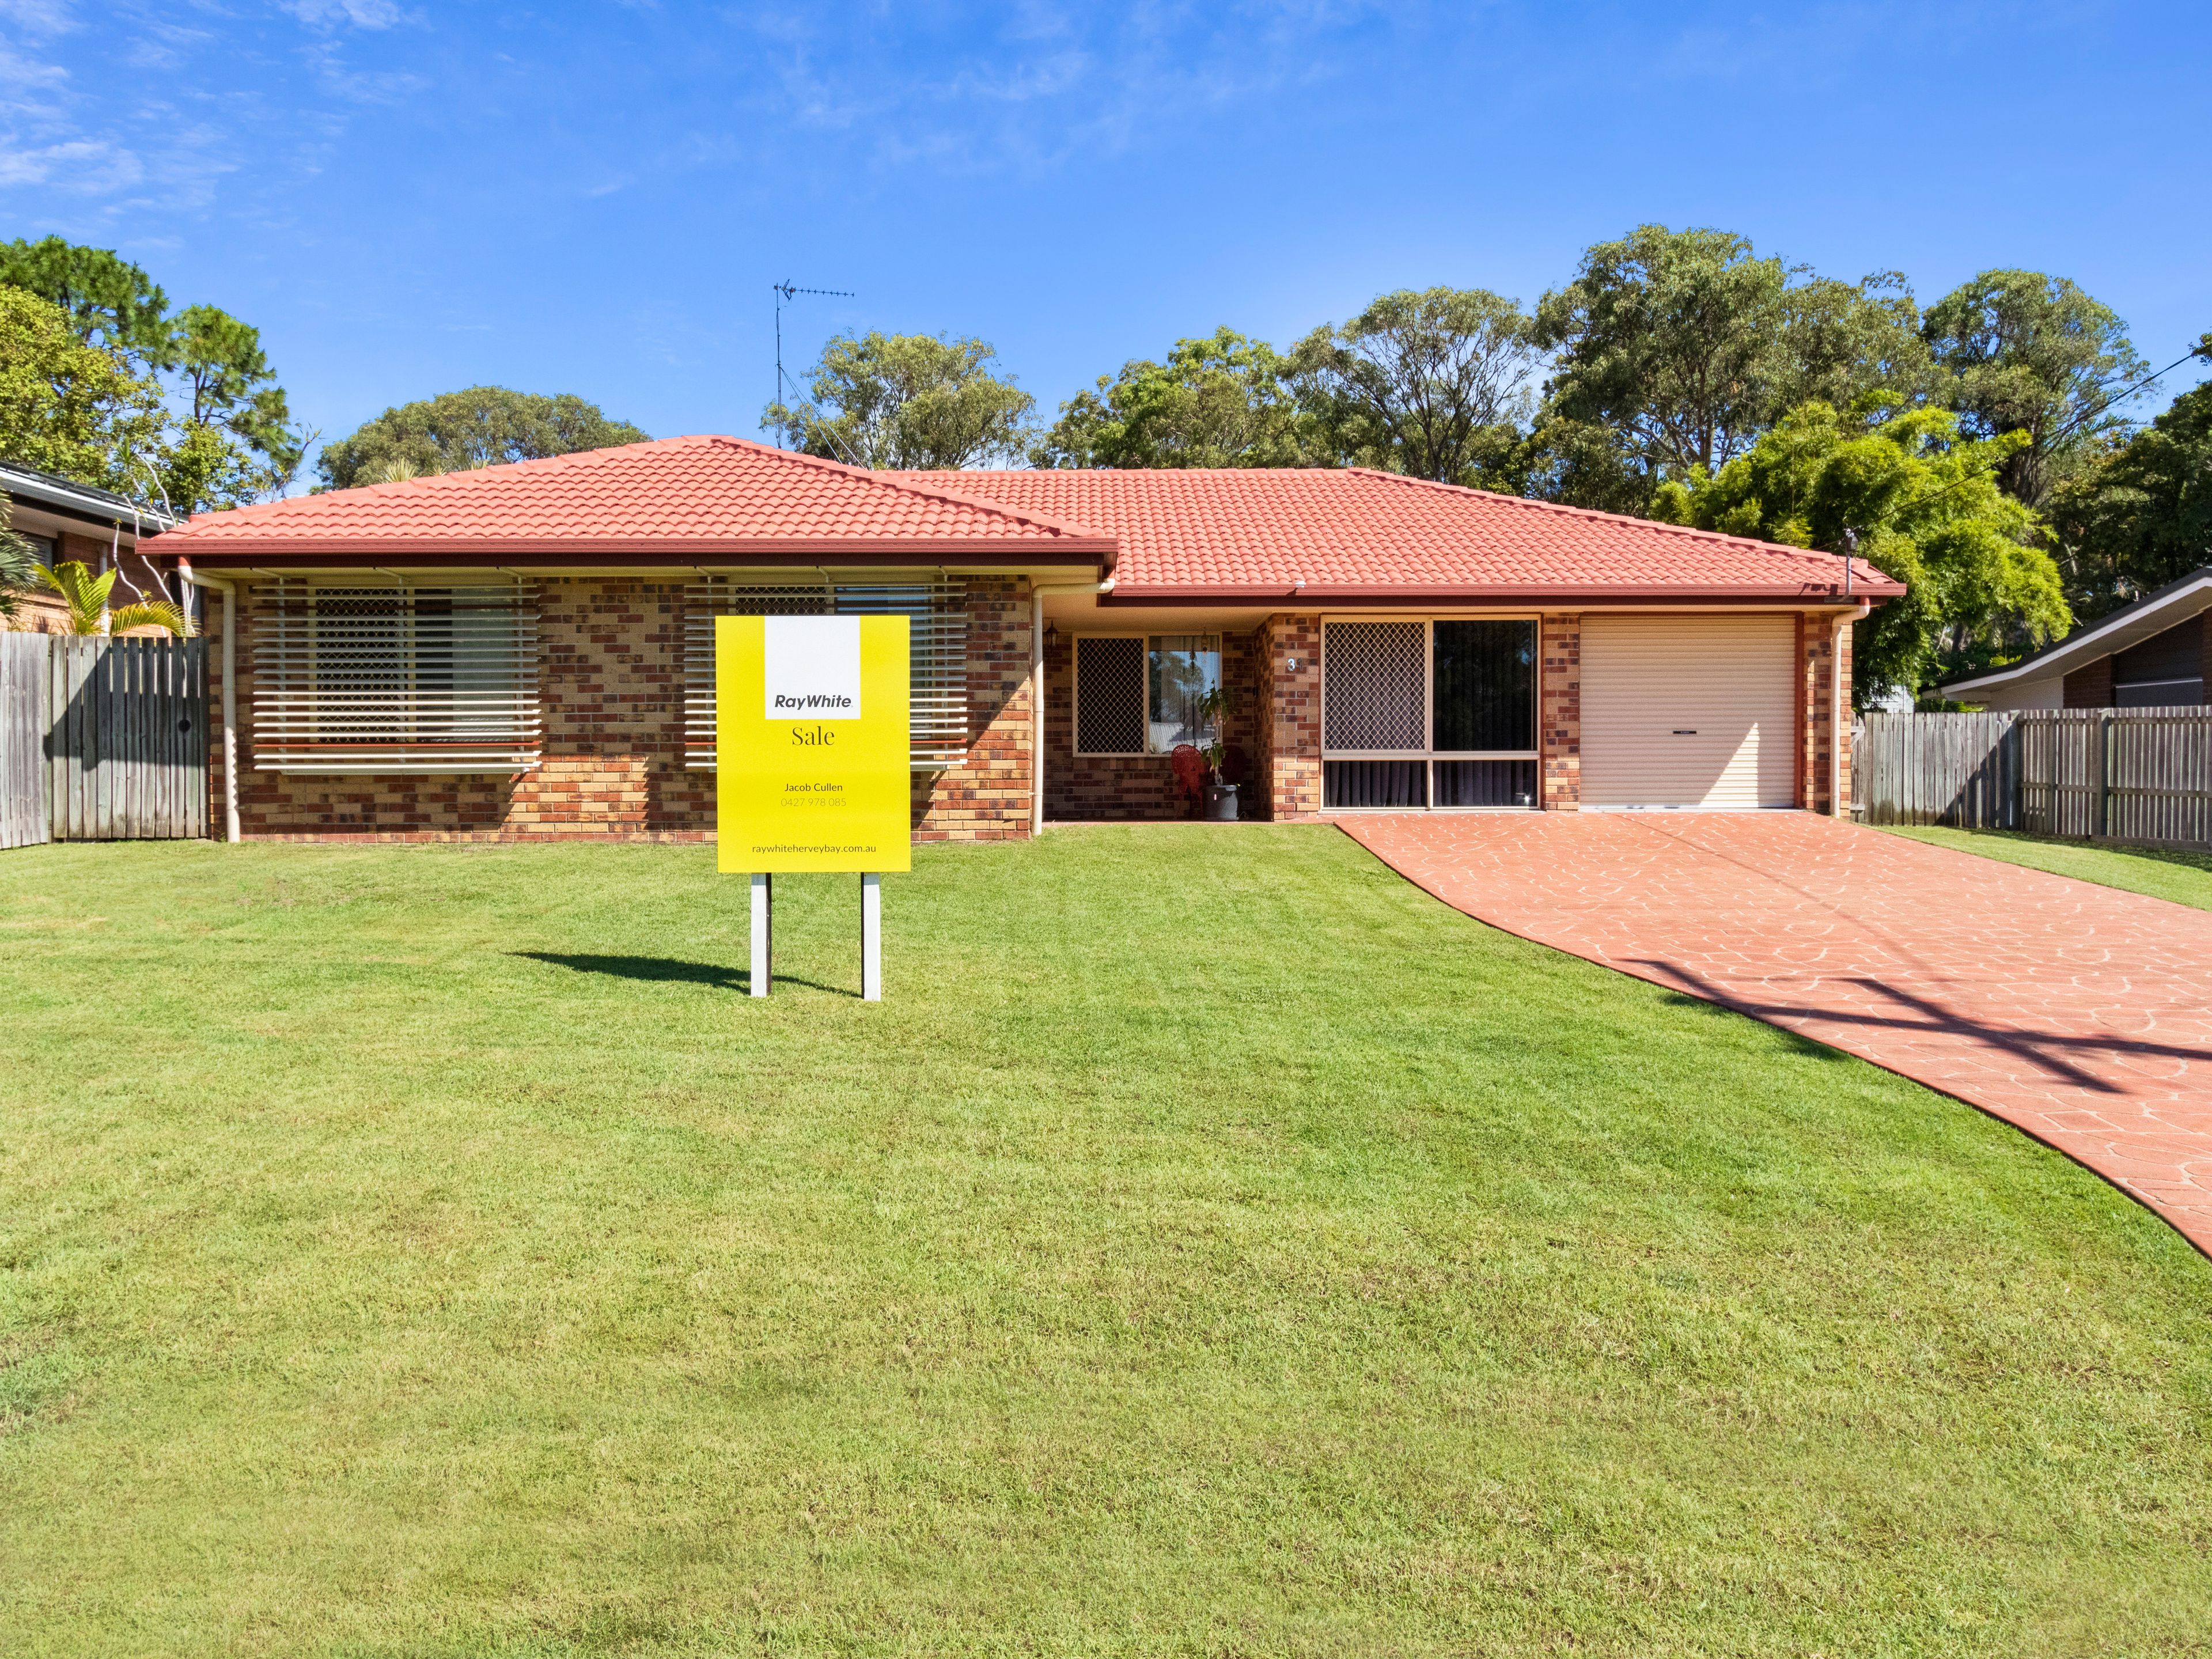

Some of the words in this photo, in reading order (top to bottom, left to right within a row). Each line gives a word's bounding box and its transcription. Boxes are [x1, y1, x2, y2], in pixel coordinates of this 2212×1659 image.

[792, 725, 835, 745] Sale
[784, 783, 811, 792] Jacob
[813, 782, 843, 792] Cullen
[781, 798, 805, 807] 0427
[808, 798, 826, 807] 978
[828, 797, 847, 807] 085
[752, 843, 876, 854] raywhiteherveybay.com.au
